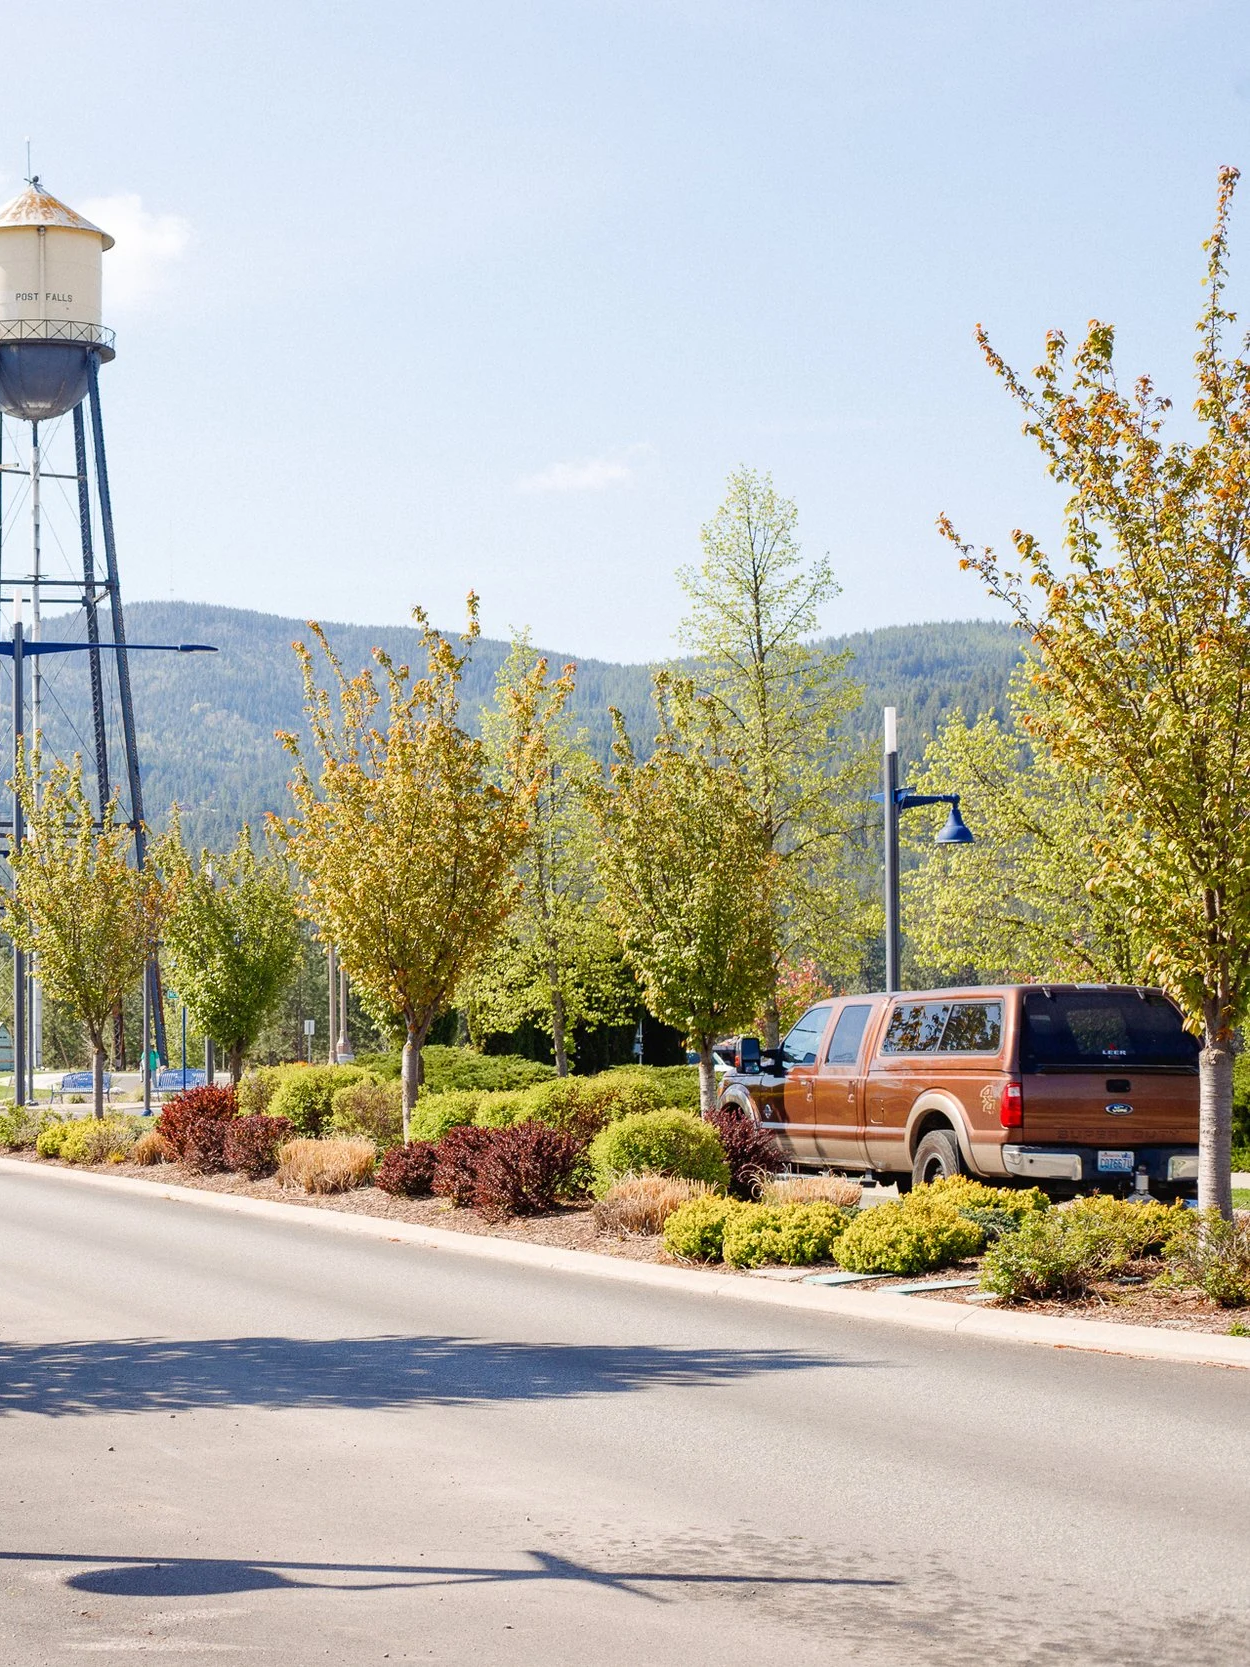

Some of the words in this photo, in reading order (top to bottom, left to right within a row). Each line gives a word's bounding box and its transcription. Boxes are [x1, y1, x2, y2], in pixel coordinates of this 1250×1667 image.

[15, 292, 39, 301] POST
[45, 292, 73, 302] FALLS
[1057, 1129, 1119, 1140] SUPER
[1132, 1130, 1180, 1140] DUTY
